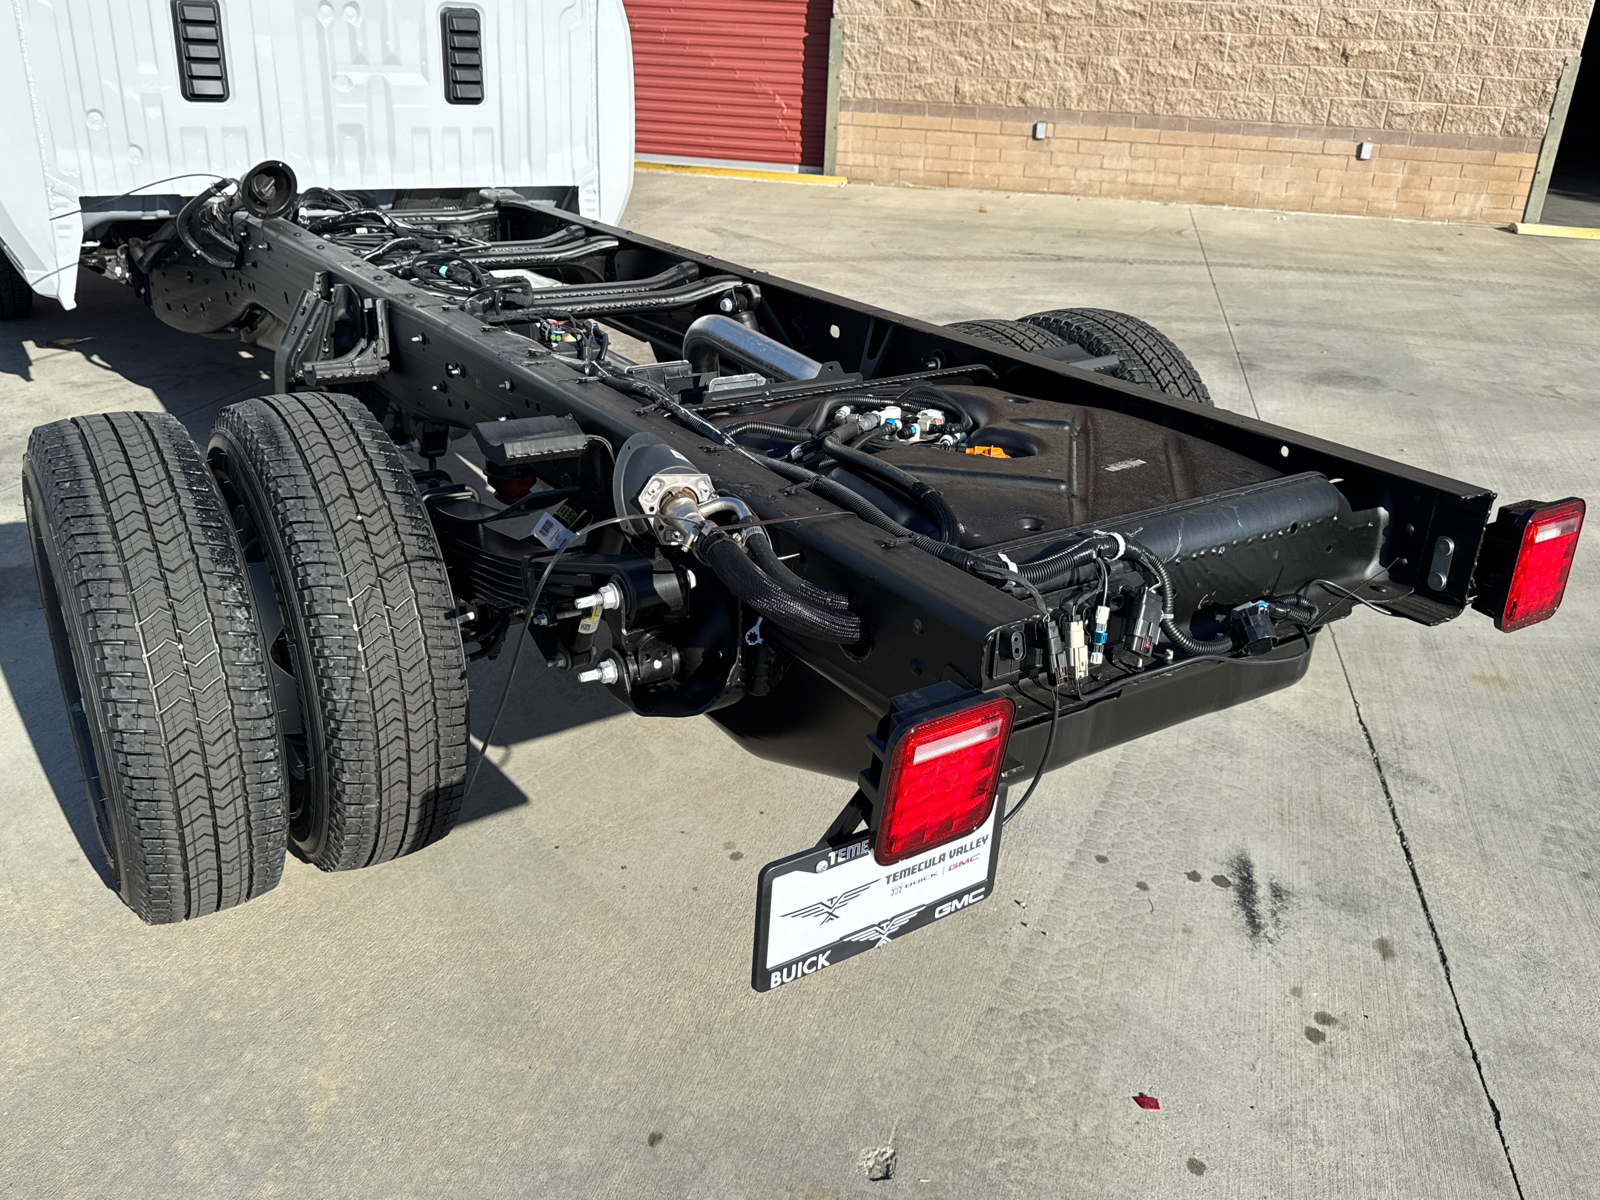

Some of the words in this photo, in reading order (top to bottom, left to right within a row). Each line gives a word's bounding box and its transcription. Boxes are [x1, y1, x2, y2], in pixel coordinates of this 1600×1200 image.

[828, 839, 870, 866] TEME
[885, 854, 947, 885] TEMECULA
[948, 834, 989, 860] VALLEY
[904, 872, 939, 889] BUICK
[947, 853, 980, 871] GMC
[770, 950, 831, 989] BUICK
[934, 887, 986, 919] GMC
